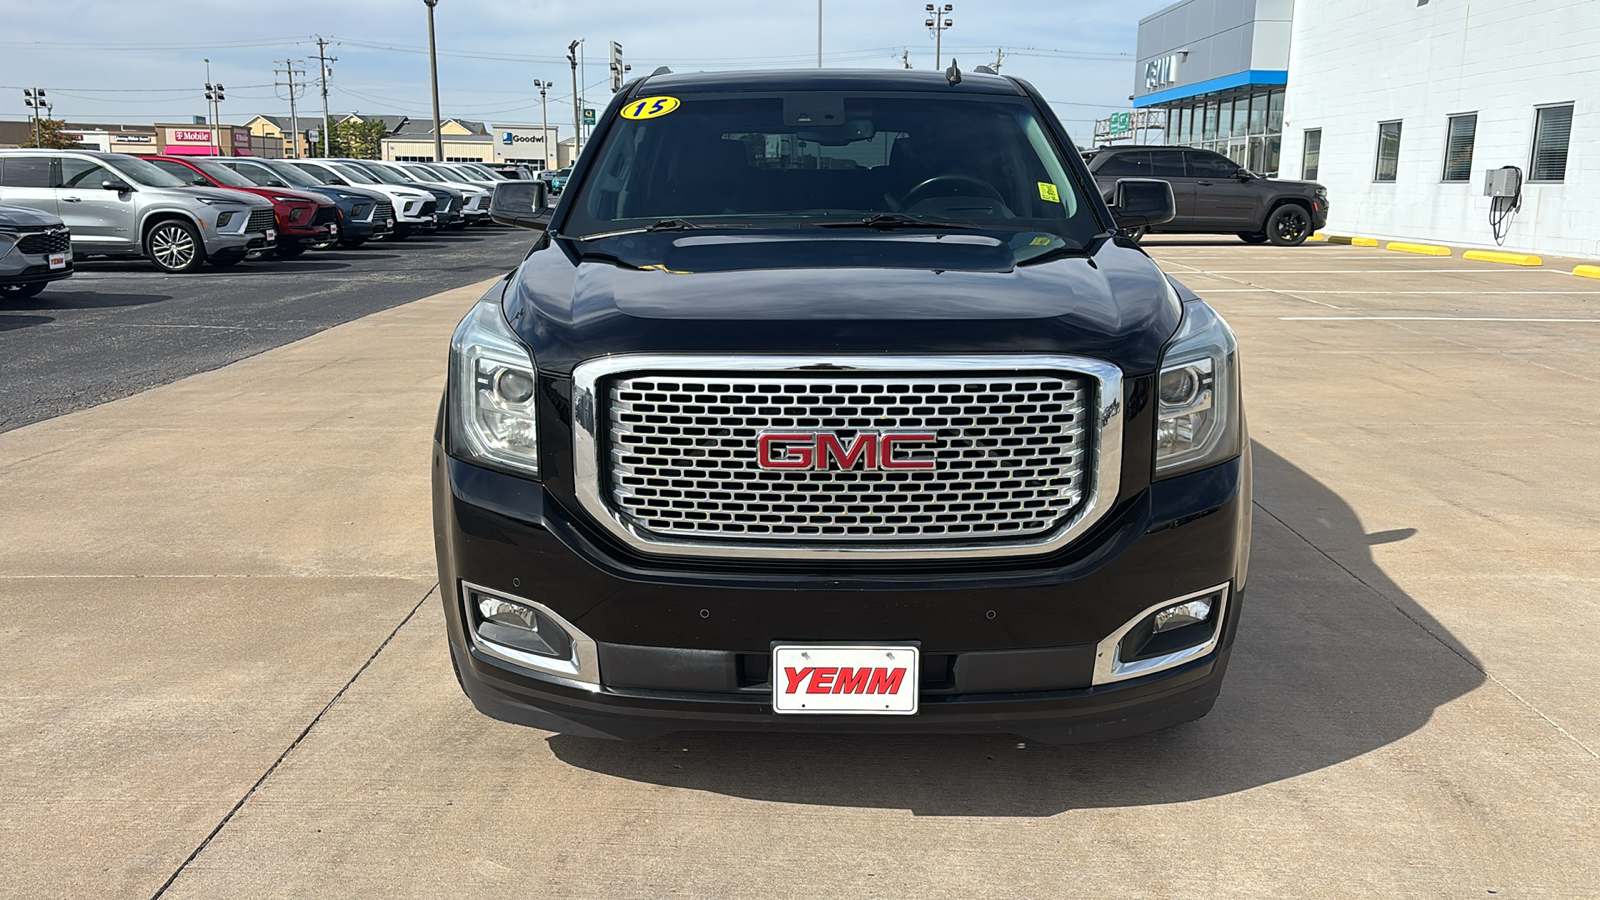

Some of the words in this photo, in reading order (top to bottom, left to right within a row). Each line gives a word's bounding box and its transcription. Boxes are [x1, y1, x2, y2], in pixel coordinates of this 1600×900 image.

[633, 99, 668, 117] 15
[513, 135, 546, 143] Goodwi
[756, 429, 938, 471] GMC
[784, 667, 907, 695] YEMM
